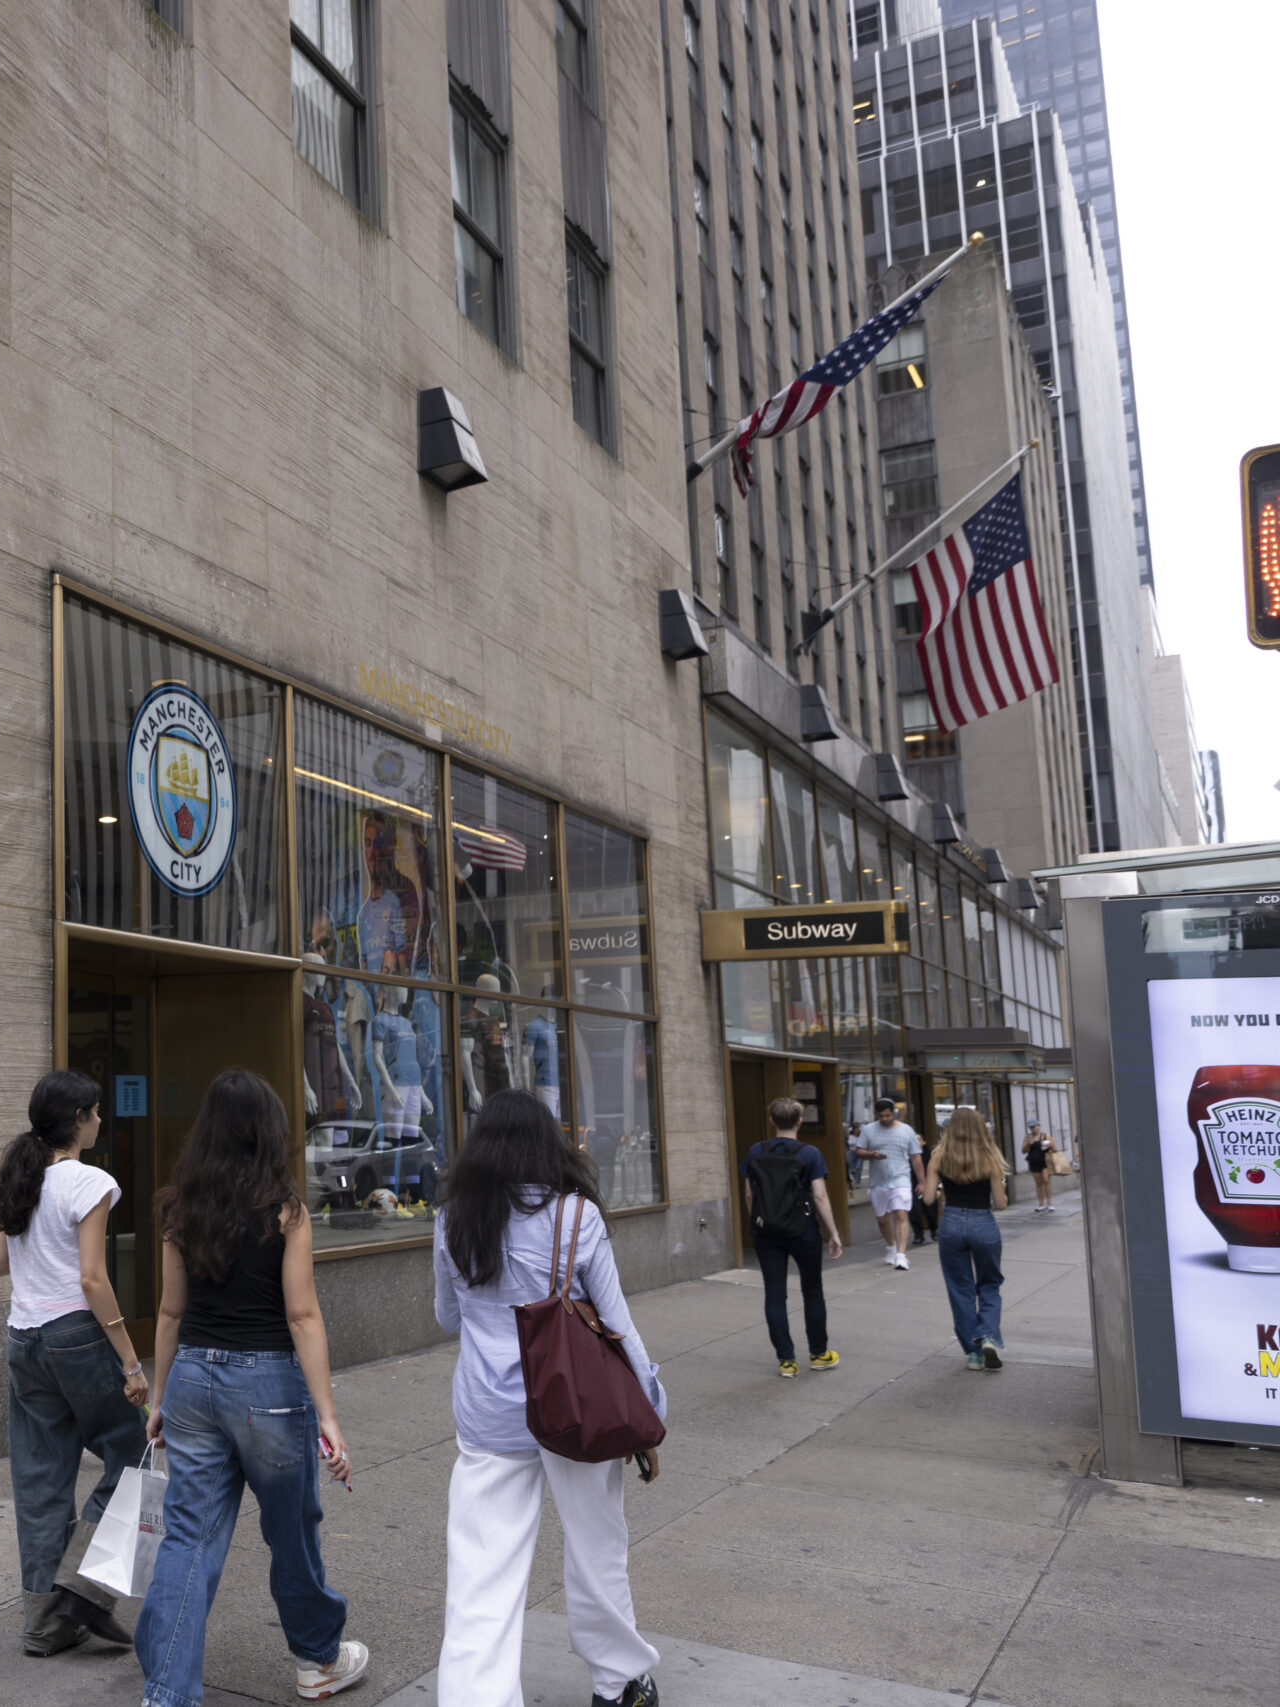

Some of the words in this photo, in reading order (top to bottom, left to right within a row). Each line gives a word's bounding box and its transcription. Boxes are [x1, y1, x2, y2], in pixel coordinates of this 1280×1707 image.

[359, 660, 477, 744] MANCHESTER
[479, 719, 512, 759] CITY
[139, 700, 225, 777] MANCHESTER
[136, 771, 145, 785] 18
[220, 797, 230, 809] 94
[170, 860, 202, 884] CITY
[1255, 895, 1280, 904] JCD
[767, 921, 858, 941] Subway
[1190, 1015, 1229, 1028] NOW
[1234, 1014, 1270, 1027] YOU
[1225, 1109, 1276, 1123] HEINZ
[1265, 1388, 1277, 1399] IT
